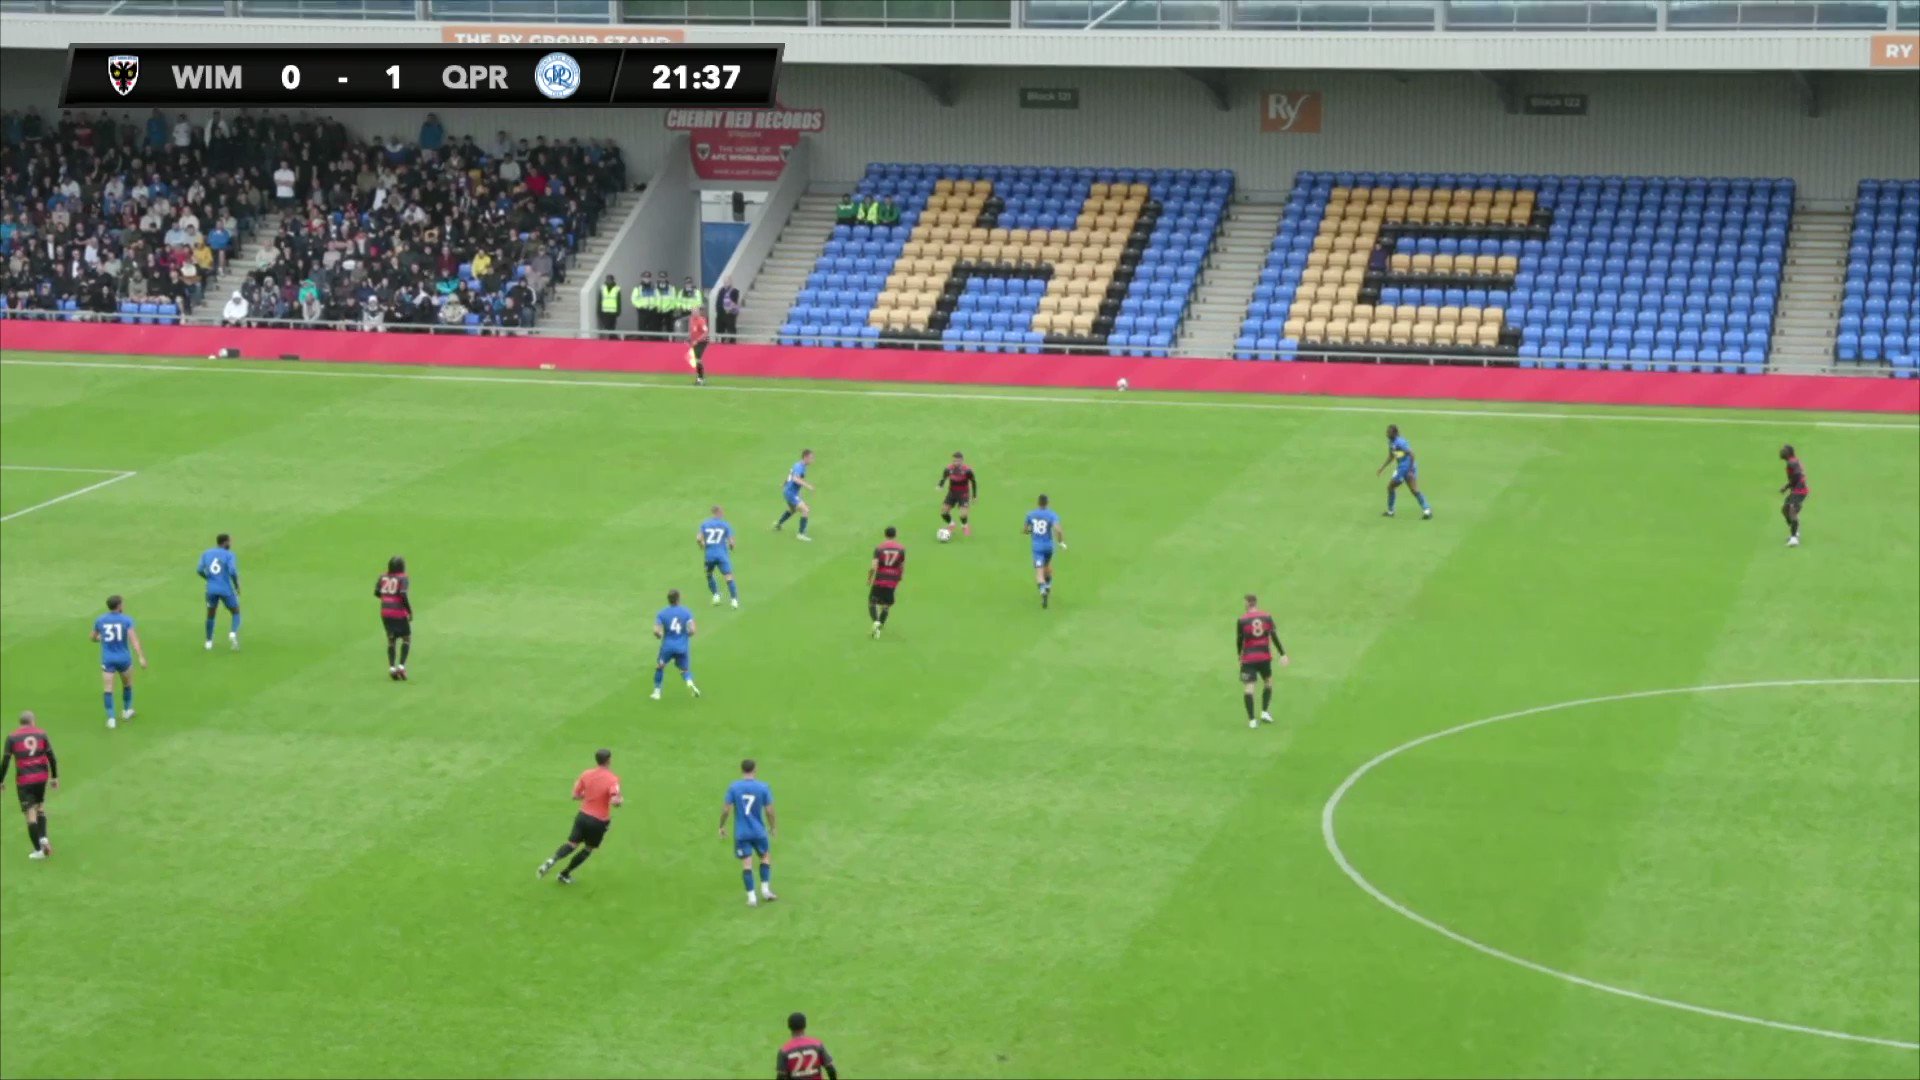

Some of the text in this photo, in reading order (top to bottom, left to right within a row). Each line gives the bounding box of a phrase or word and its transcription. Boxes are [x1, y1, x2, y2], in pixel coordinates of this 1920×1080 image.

[1886, 44, 1913, 58] RY
[667, 110, 822, 129] CHERRY RED RECORDS
[1267, 94, 1310, 130] Ry
[1032, 518, 1047, 535] 18
[705, 527, 724, 545] 27
[210, 558, 221, 574] 6
[883, 550, 899, 566] 17
[381, 577, 398, 594] 20
[103, 623, 122, 641] 31
[670, 616, 682, 634] 4
[1252, 618, 1264, 636] 8
[24, 735, 37, 756] 9
[742, 794, 755, 816] 7
[787, 1050, 819, 1077] 22
